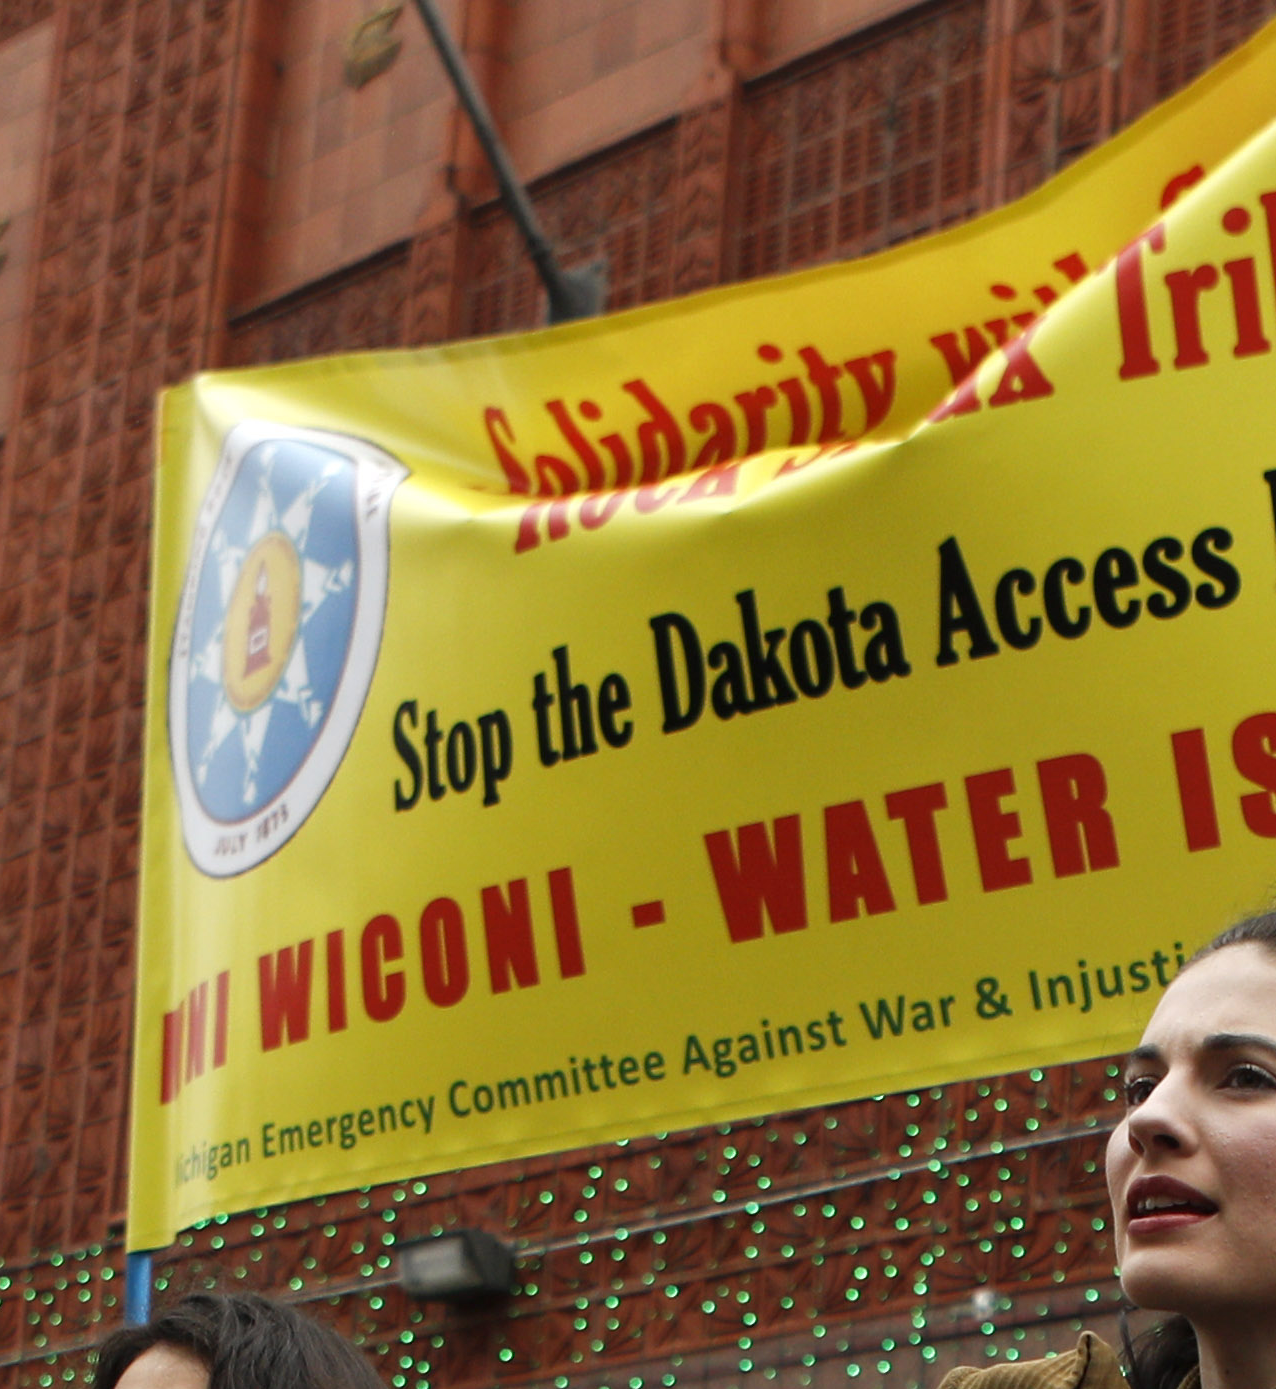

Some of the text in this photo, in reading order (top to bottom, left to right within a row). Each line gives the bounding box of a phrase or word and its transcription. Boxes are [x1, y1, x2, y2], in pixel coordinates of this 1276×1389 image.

[484, 343, 896, 496] Solidarity
[392, 699, 513, 812] Stop
[532, 645, 633, 769] the
[649, 586, 911, 735] Dakota
[935, 535, 1242, 667] Access
[258, 866, 586, 1054] WICONI
[703, 752, 1121, 945] WATER
[175, 941, 1187, 1188] ichigan Emergency Committee Against War & Injusti
